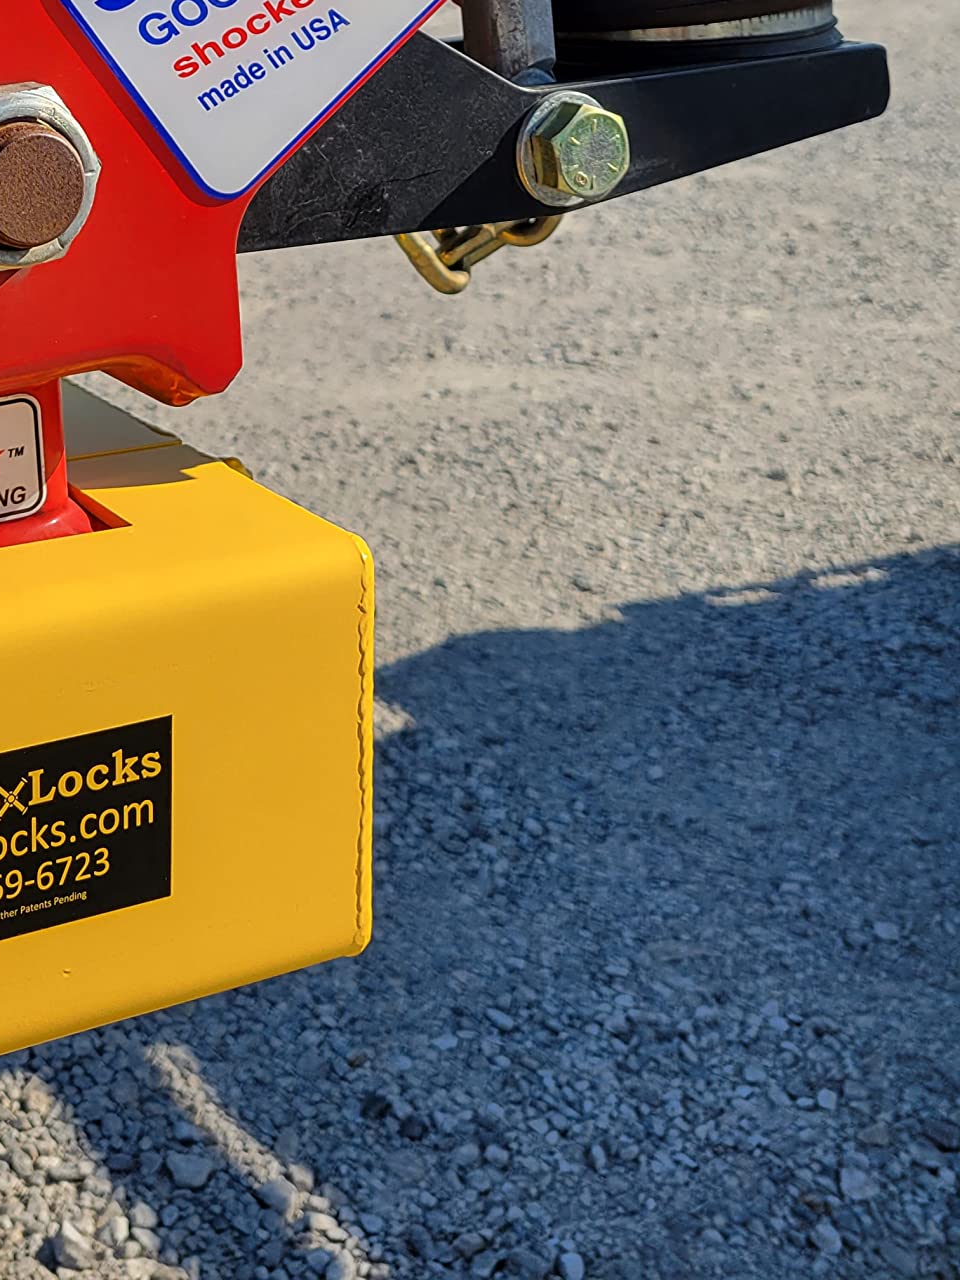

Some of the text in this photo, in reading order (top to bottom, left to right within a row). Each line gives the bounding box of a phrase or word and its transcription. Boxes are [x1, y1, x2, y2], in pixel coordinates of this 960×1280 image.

[197, 9, 351, 111] made in USA
[20, 900, 52, 915] Patents
[53, 890, 87, 906] Pending
